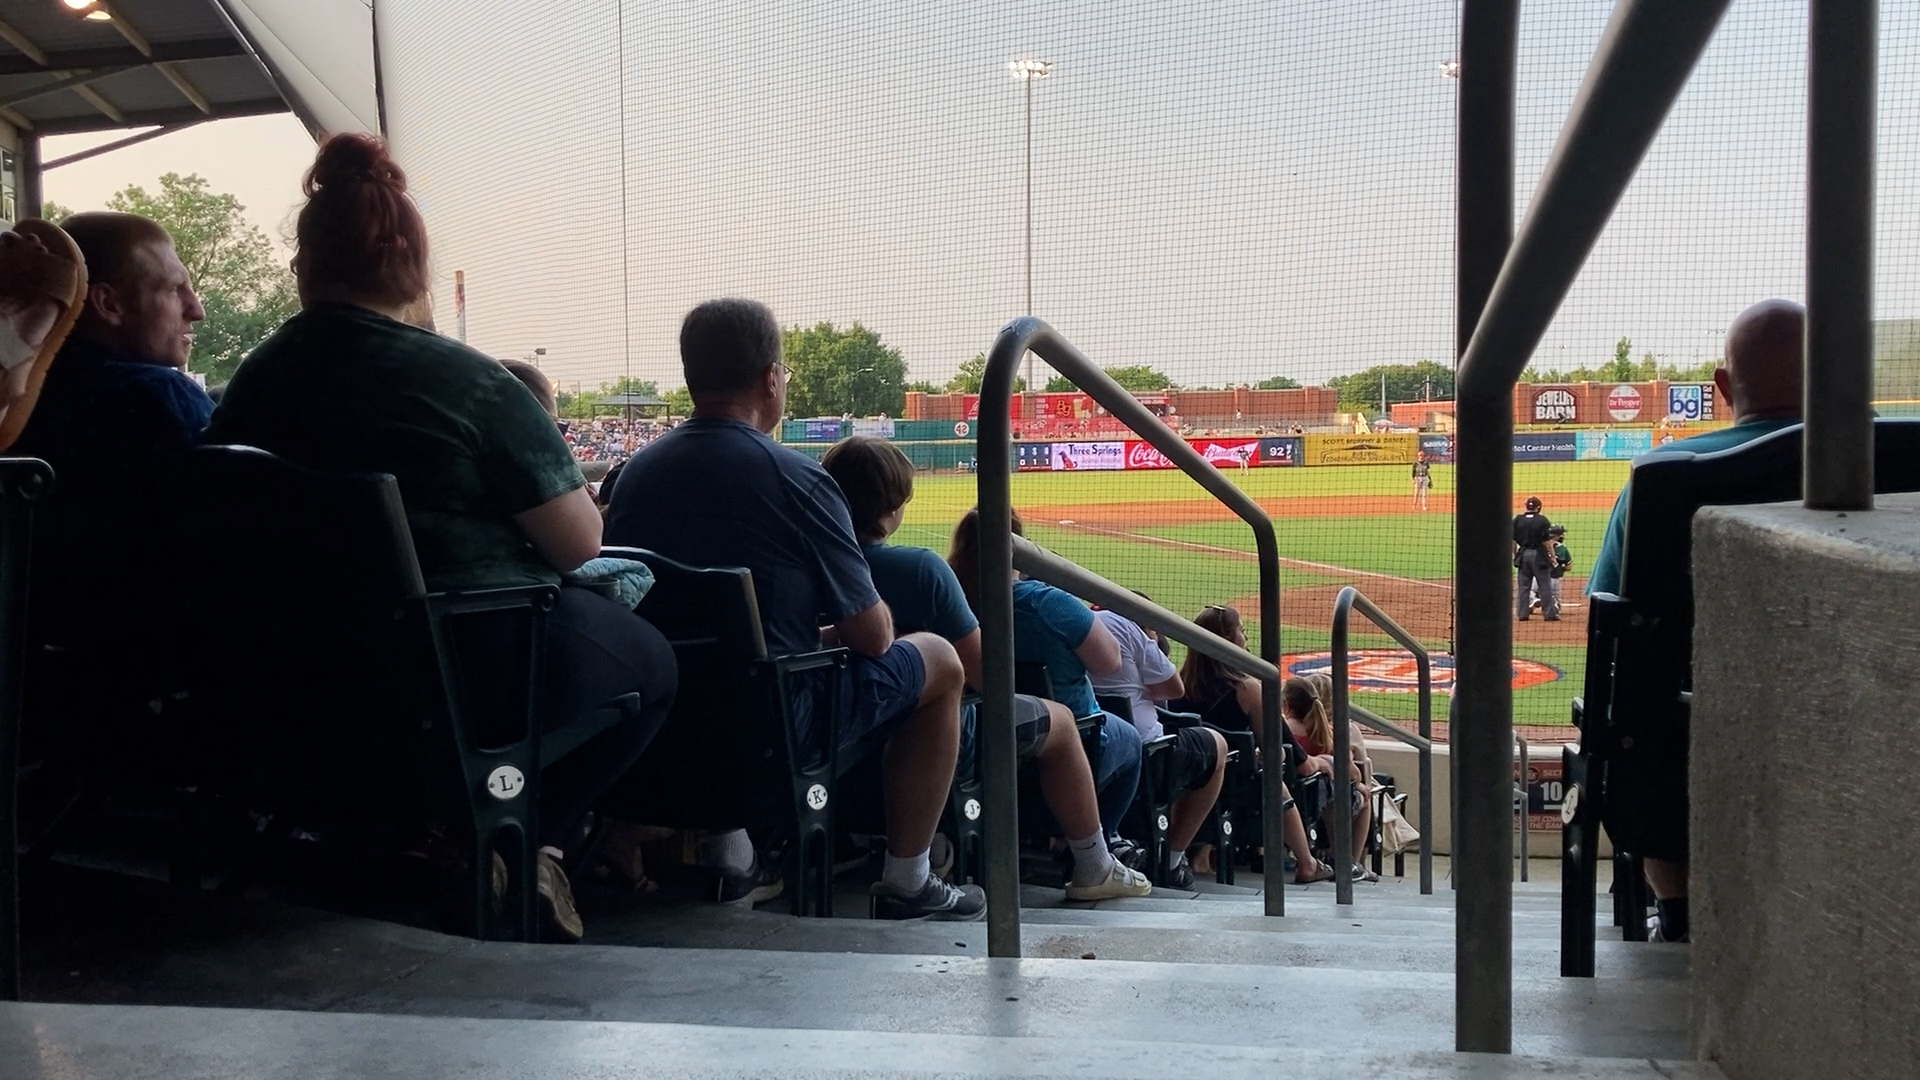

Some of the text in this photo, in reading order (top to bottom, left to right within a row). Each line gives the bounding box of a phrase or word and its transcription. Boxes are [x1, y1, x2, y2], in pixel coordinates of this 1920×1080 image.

[1536, 406, 1576, 419] BARN
[1068, 444, 1122, 456] Three Springs
[1269, 446, 1285, 457] 92
[499, 775, 513, 791] L
[812, 790, 823, 804] K
